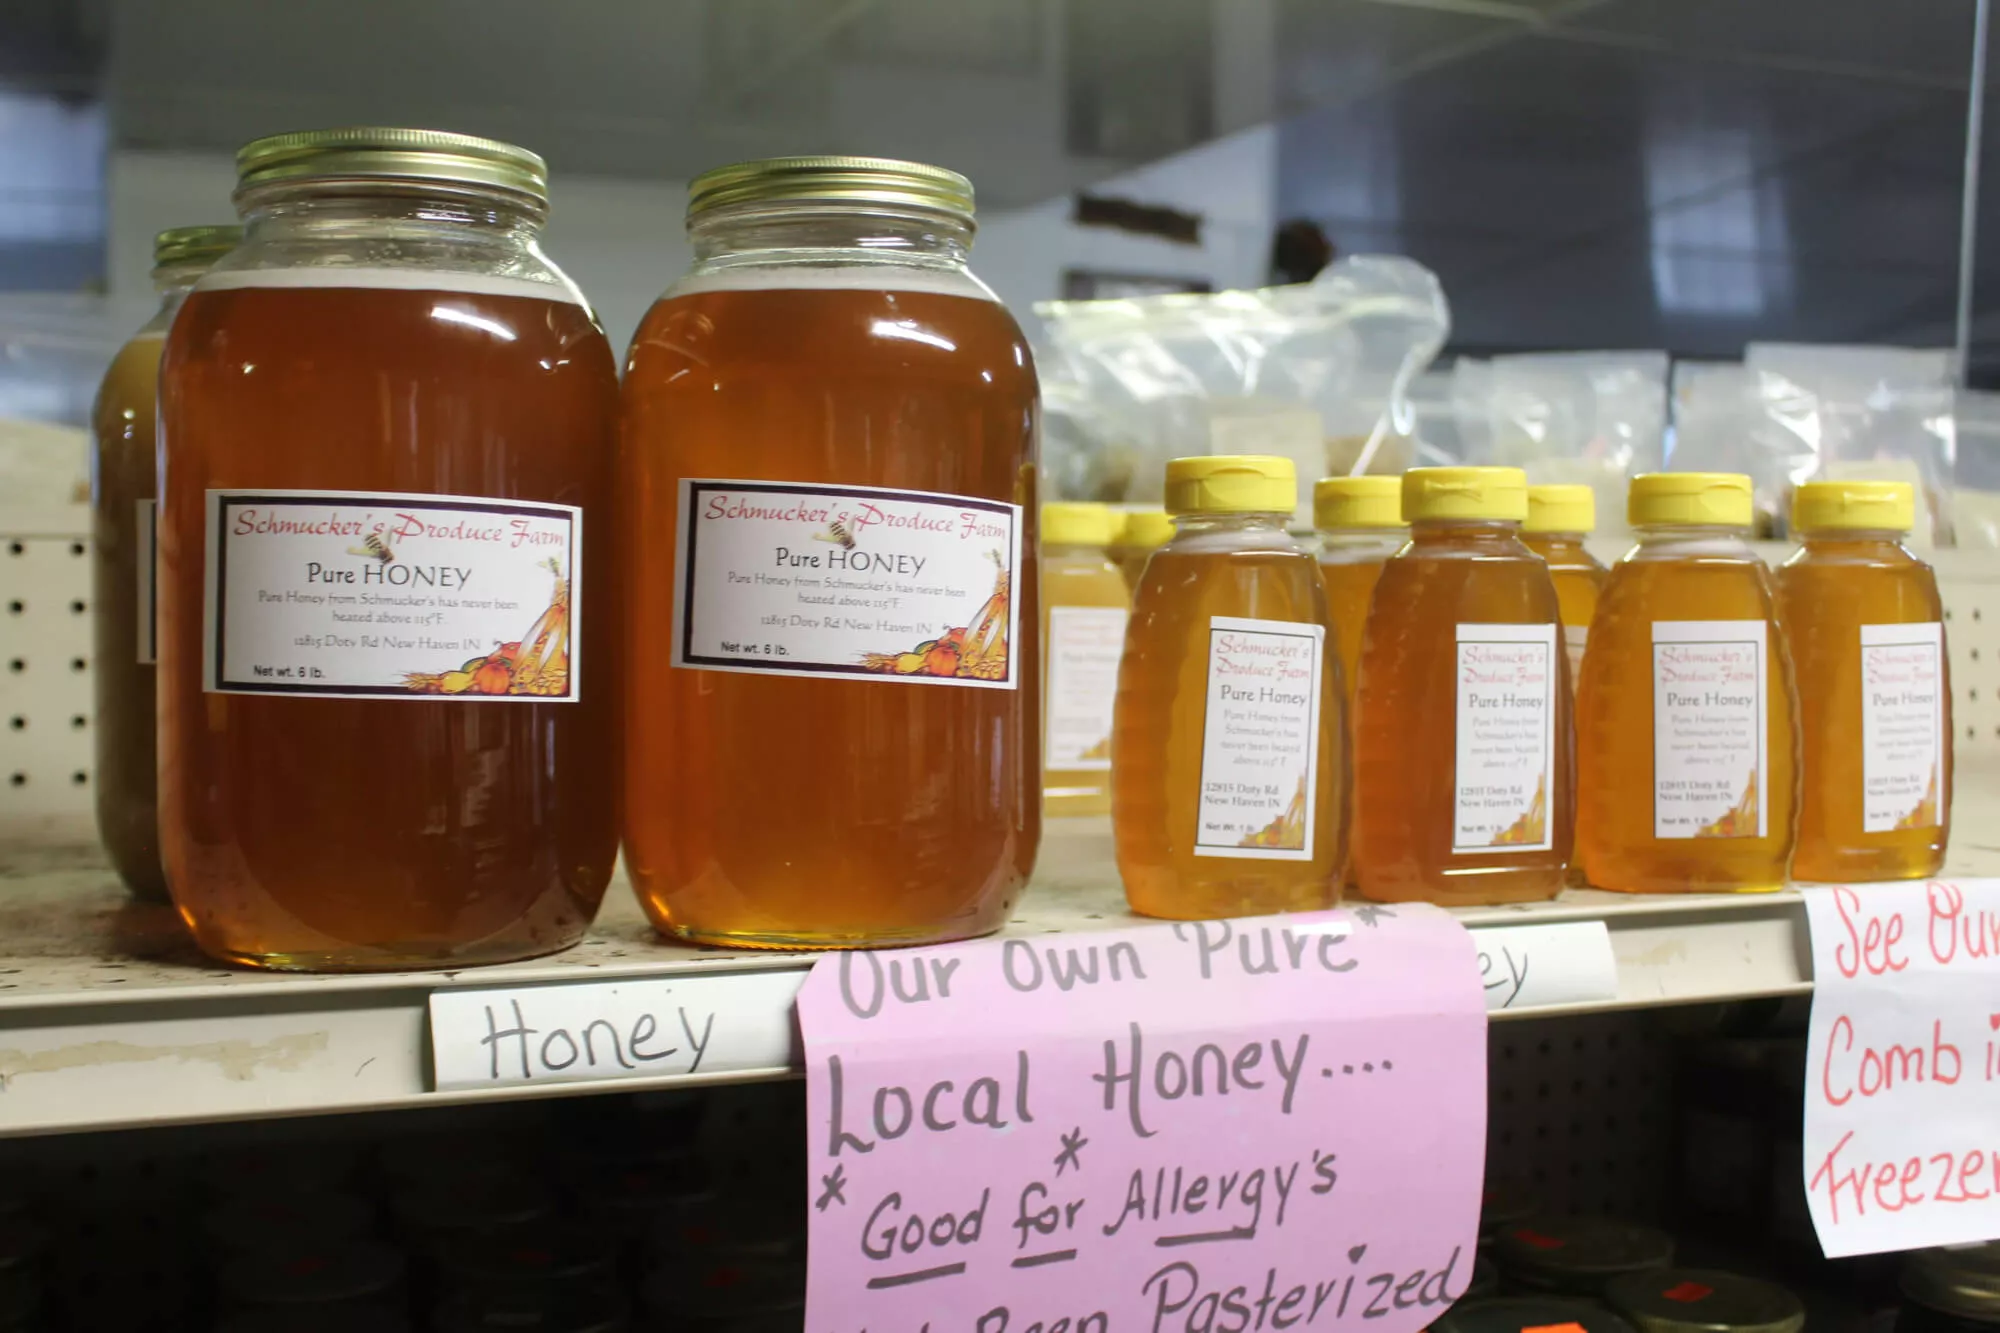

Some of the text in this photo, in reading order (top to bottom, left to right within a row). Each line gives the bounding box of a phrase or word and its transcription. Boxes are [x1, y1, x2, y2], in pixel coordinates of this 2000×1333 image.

[233, 508, 565, 549] Schmucker's Produce Farm
[704, 495, 1006, 540] Schmucker's Produce Farm
[775, 547, 927, 578] Pure HONEY
[307, 561, 472, 592] Pure HONEY
[728, 571, 752, 584] Pure
[755, 573, 791, 587] Honey
[795, 575, 820, 587] from
[824, 577, 892, 592] Schmucker's
[895, 582, 914, 594] has
[917, 585, 943, 596] never
[258, 589, 519, 610] Pure Honey from Schmucker's has never been
[798, 592, 836, 606] heated
[838, 595, 870, 607] above
[332, 609, 373, 623] heated
[376, 611, 412, 624] above
[789, 614, 820, 629] Doty
[823, 616, 841, 629] Rd
[844, 618, 873, 630] New
[876, 620, 914, 633] Haven
[916, 623, 932, 634] IN
[325, 634, 357, 648] Doty
[360, 635, 379, 648] Rd
[383, 637, 417, 649] New
[418, 637, 460, 650] Haven
[463, 638, 481, 650] IN
[720, 641, 741, 653] Net
[763, 644, 772, 655] 6
[775, 644, 790, 656] lb.
[1216, 634, 1310, 659] Schmucker's
[253, 665, 274, 677] Net
[298, 666, 306, 678] 6
[310, 666, 326, 679] lb.
[1216, 656, 1310, 682] Produce Farm
[1220, 684, 1307, 708] Pure Honey
[1469, 692, 1544, 711] Pure Honey
[1667, 691, 1754, 711] Pure Honey
[1832, 886, 1910, 979] See
[838, 920, 1359, 1019] Our Own Pure
[480, 998, 715, 1081] Honey
[1823, 1011, 2000, 1107] Comb i
[826, 1048, 1035, 1157] Local
[860, 1149, 1339, 1262] Good for Allergy's
[1141, 1243, 1462, 1333] Pasterized
